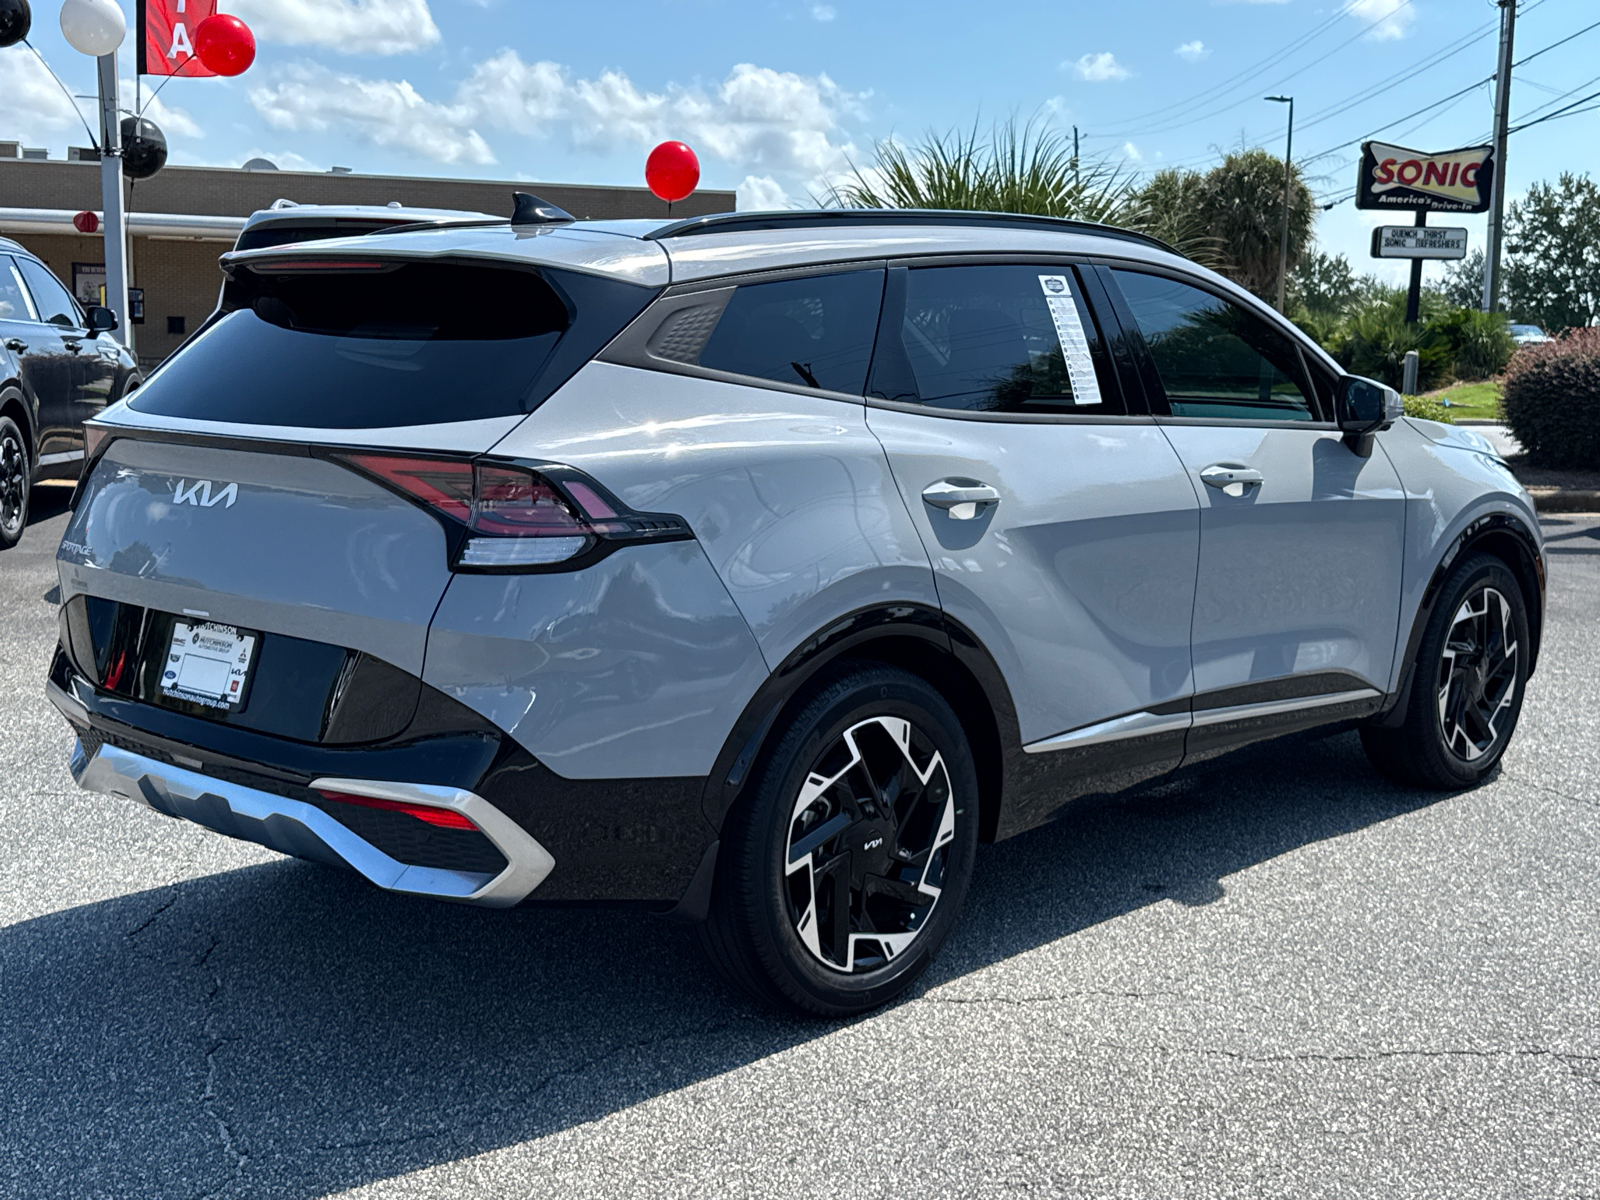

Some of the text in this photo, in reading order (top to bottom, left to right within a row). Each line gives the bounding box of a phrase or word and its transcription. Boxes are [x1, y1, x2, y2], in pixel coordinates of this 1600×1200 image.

[1375, 158, 1482, 188] SONIC
[1378, 194, 1473, 210] America's Drive-In
[1391, 230, 1447, 239] QUENCH THIRST
[1384, 238, 1461, 249] SONIC REFRESHERS
[173, 478, 238, 509] KIA
[200, 636, 233, 649] HUTCHINSON
